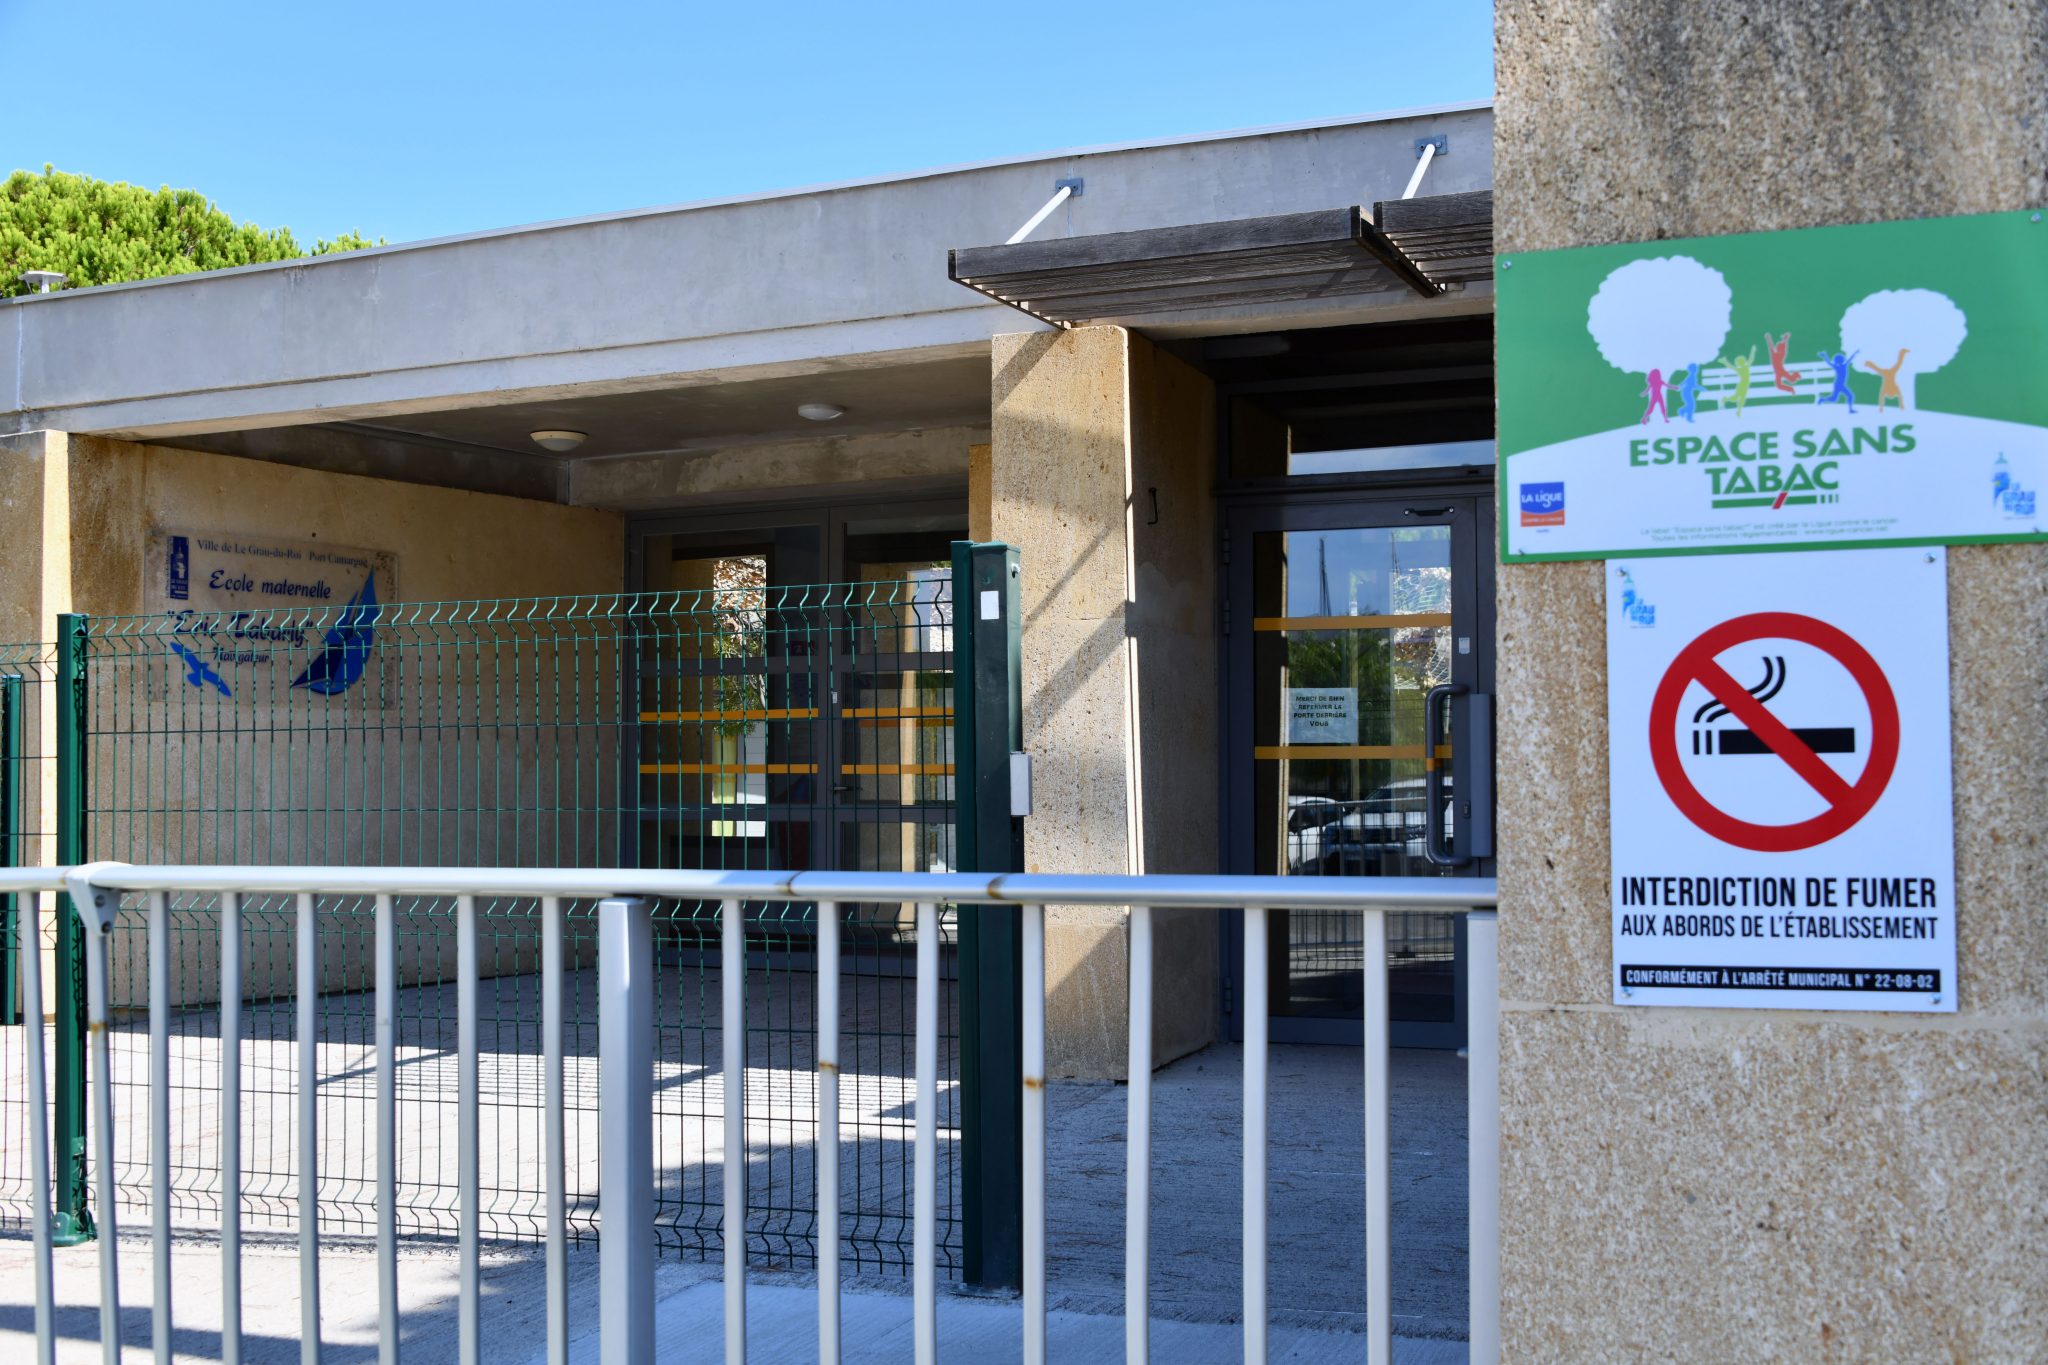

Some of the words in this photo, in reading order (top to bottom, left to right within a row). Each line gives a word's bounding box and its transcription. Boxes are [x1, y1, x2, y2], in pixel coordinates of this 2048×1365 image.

[1629, 429, 1779, 467] ESPACE
[1793, 422, 1917, 457] SANS
[1704, 460, 1840, 494] TABAC
[197, 539, 219, 551] Ville
[221, 542, 232, 553] de
[235, 544, 246, 554] Le
[209, 569, 254, 592] Ecole
[261, 579, 331, 599] maternelle
[213, 646, 269, 664] Navgateur
[1621, 877, 1796, 907] INTERDICTION
[1805, 878, 1838, 907] DE
[1847, 878, 1937, 908] FUMER
[1621, 914, 1657, 937] AUX
[1663, 915, 1735, 938] ABORDS
[1741, 916, 1764, 939] DE
[1770, 911, 1938, 939] L'ÉTABLISSEMENT
[1626, 969, 1719, 985] CONFORMÉMENT
[1721, 969, 1730, 985] À
[1732, 970, 1785, 986] L'ARRÊTÉ
[1788, 972, 1852, 987] MUNICIPAL
[1855, 973, 1871, 987] N°
[1874, 973, 1934, 988] 22-08-02
